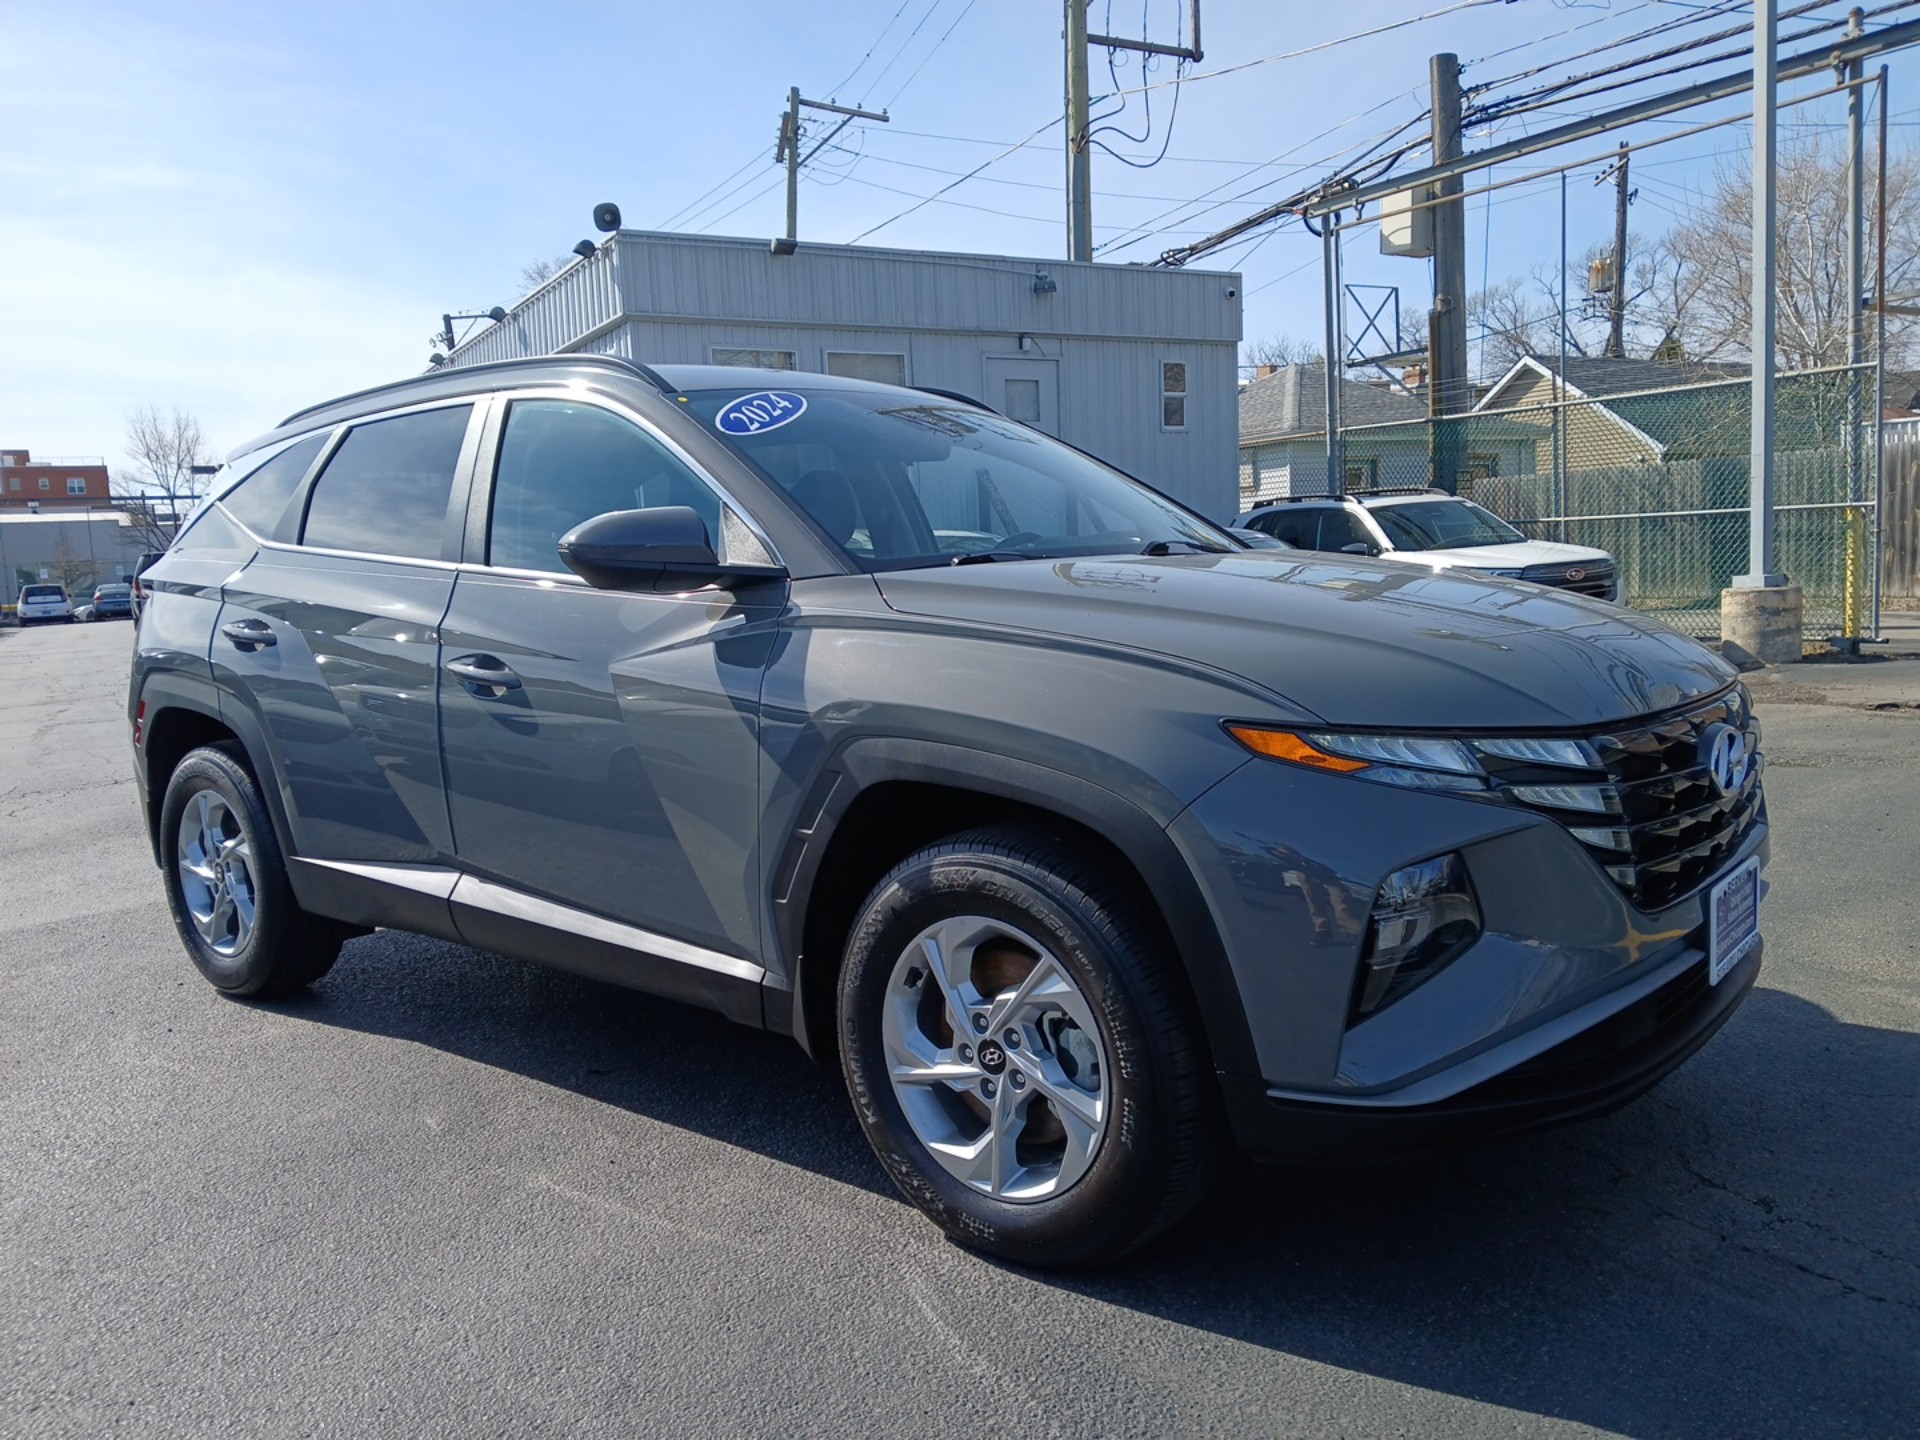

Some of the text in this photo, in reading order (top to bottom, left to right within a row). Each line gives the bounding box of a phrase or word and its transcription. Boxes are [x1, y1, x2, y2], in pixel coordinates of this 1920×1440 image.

[728, 393, 793, 431] 2024
[979, 880, 1097, 977] CRUGEN HP71
[846, 1018, 878, 1124] KUMHO
